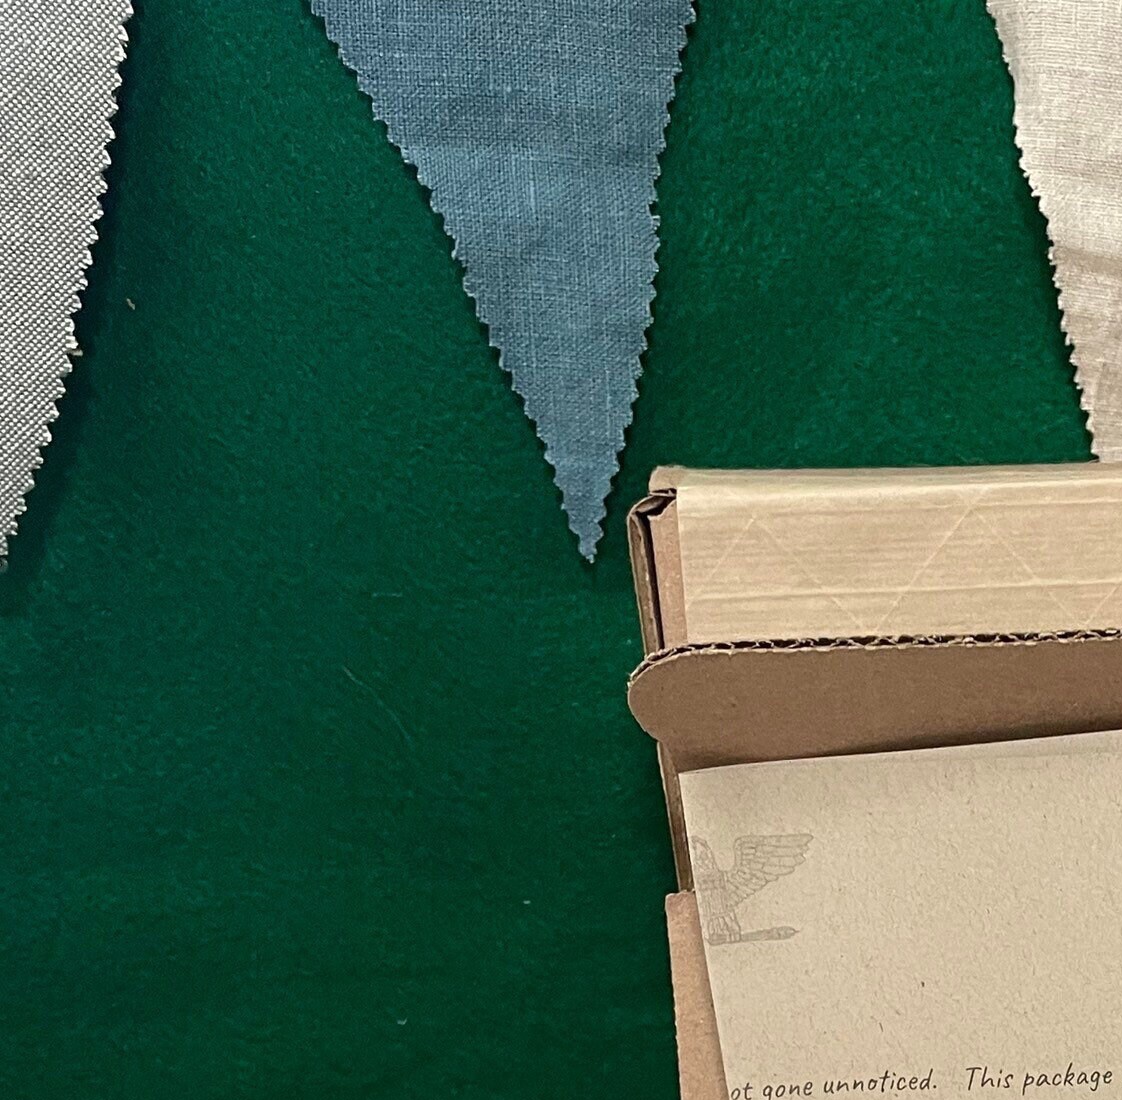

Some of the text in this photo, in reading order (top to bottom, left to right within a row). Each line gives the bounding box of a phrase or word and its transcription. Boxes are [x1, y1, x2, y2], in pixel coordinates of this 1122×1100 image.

[823, 1068, 938, 1094] unnoticed.
[965, 1066, 1014, 1091] This
[1022, 1062, 1113, 1096] package
